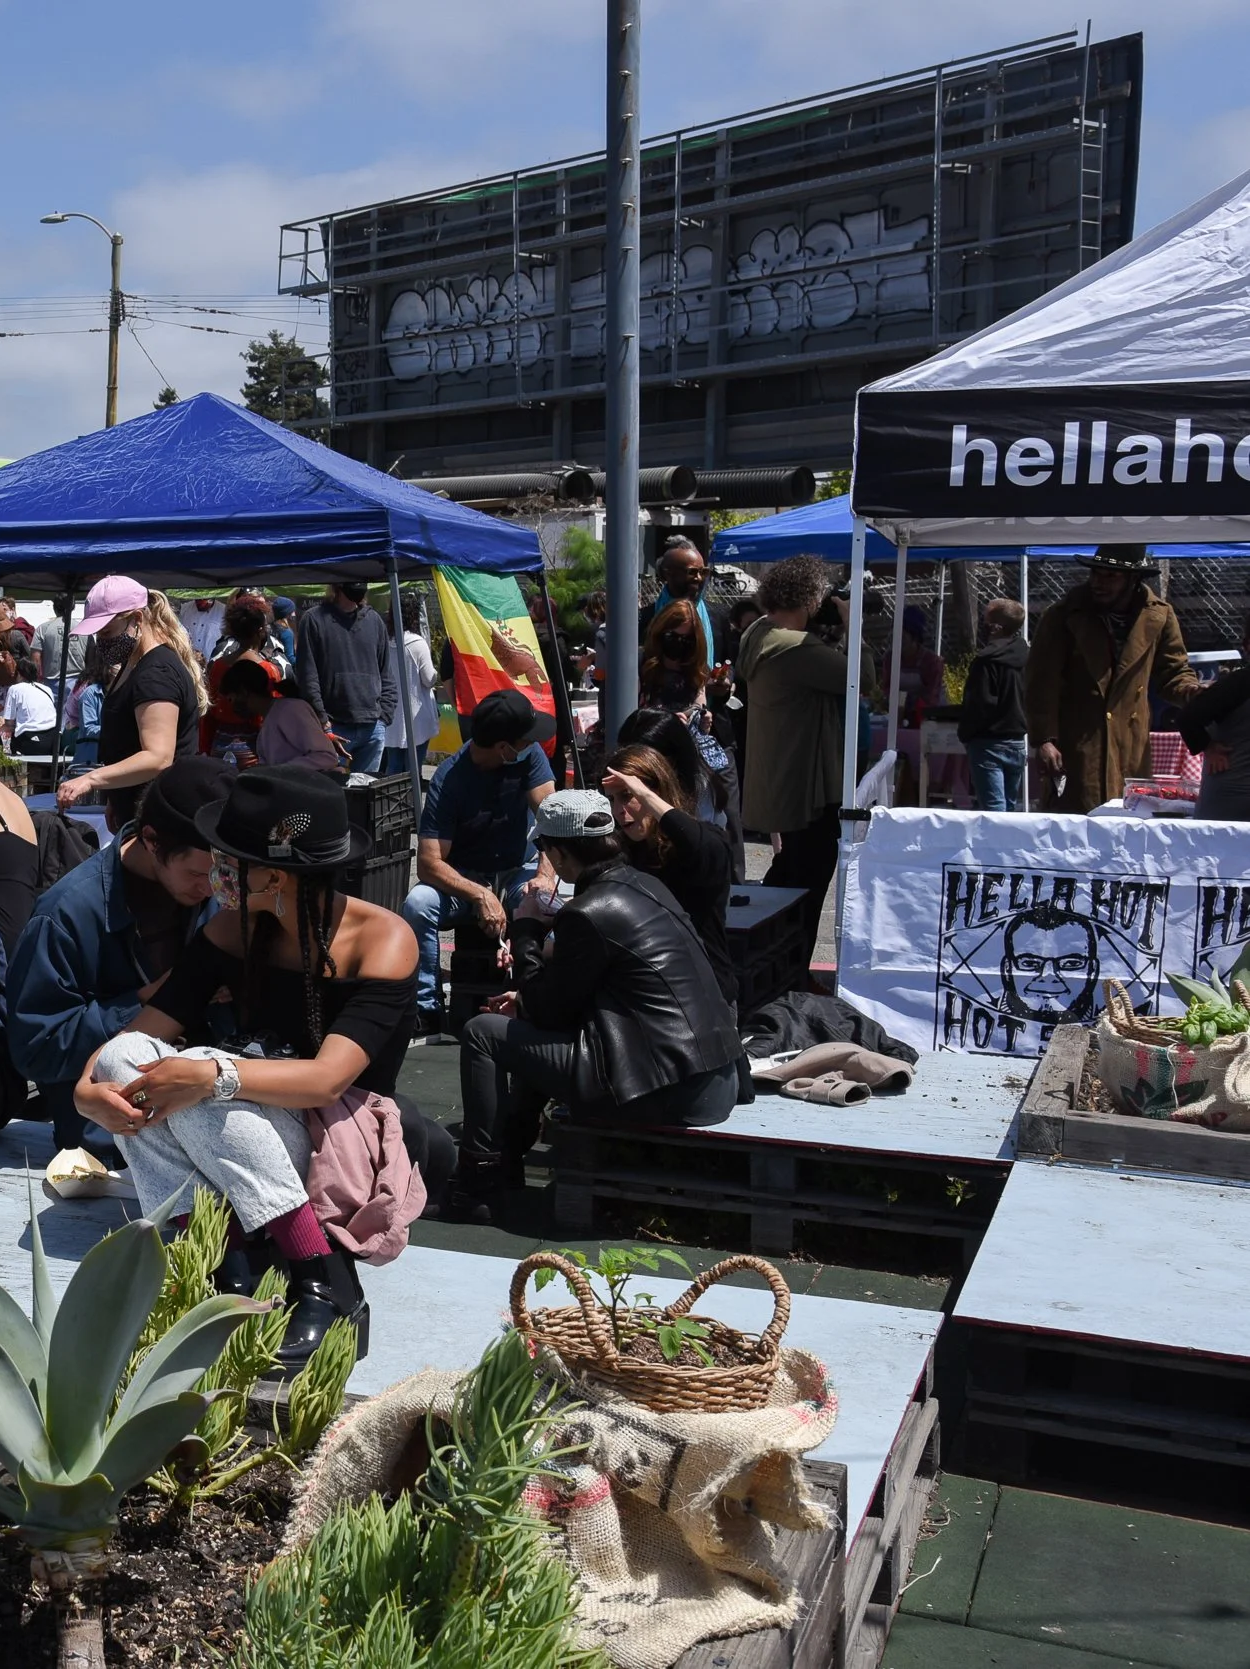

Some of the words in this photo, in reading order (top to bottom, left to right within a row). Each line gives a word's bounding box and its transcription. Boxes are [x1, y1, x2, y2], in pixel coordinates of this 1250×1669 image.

[946, 871, 1078, 932] HELLA
[1090, 878, 1168, 951] HOT
[944, 990, 1027, 1053] HOT
